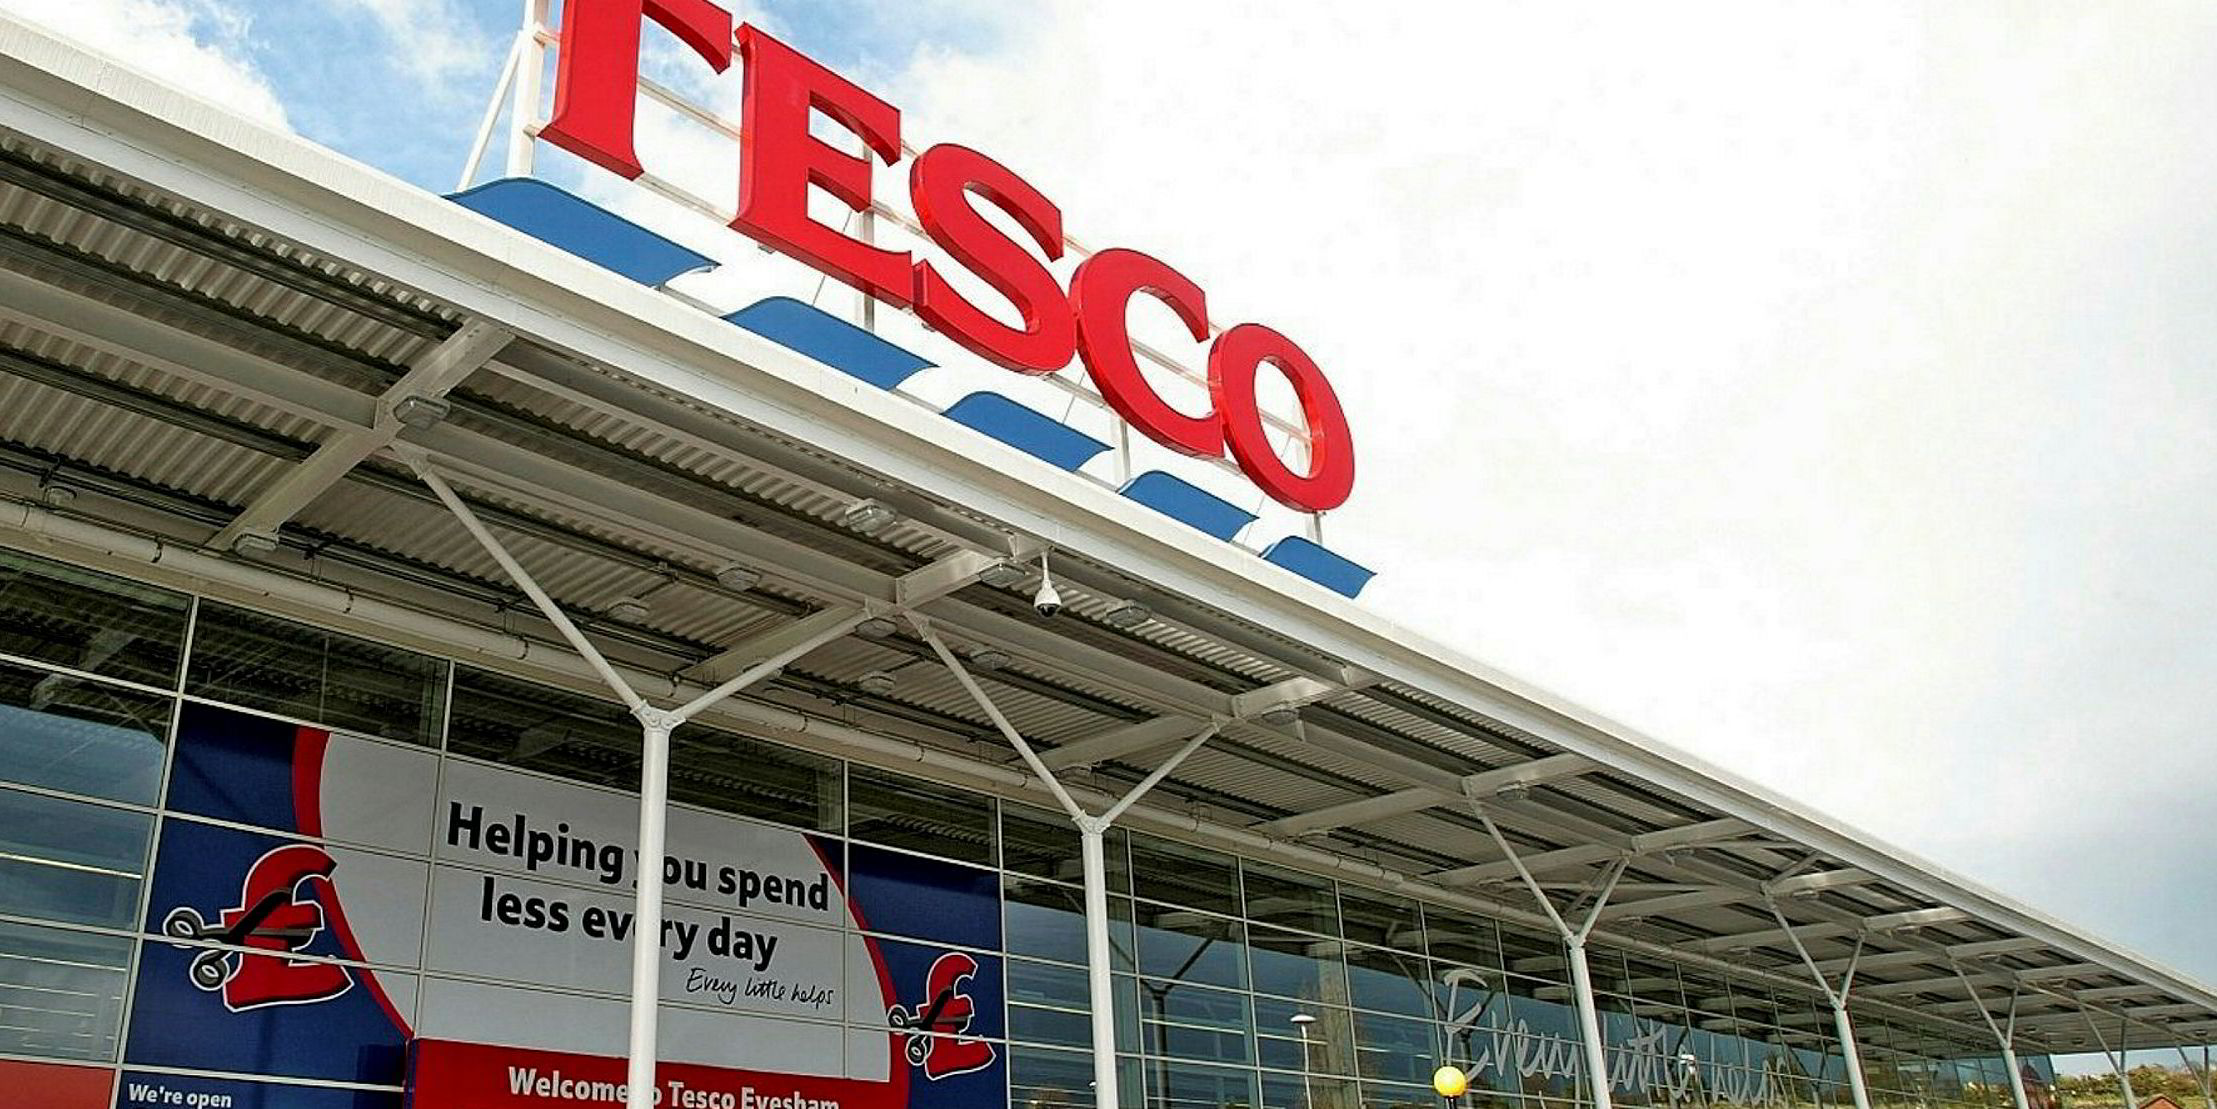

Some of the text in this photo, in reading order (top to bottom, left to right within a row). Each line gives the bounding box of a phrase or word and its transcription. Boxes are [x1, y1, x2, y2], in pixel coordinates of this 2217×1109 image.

[447, 801, 829, 912] Helping ou spend
[481, 876, 778, 972] less evry day
[686, 967, 834, 1009] Every little helps
[128, 1083, 232, 1109] We're open
[508, 1066, 628, 1103] Welcome
[668, 1081, 736, 1109] Tesco
[741, 1086, 840, 1109] Evesham
